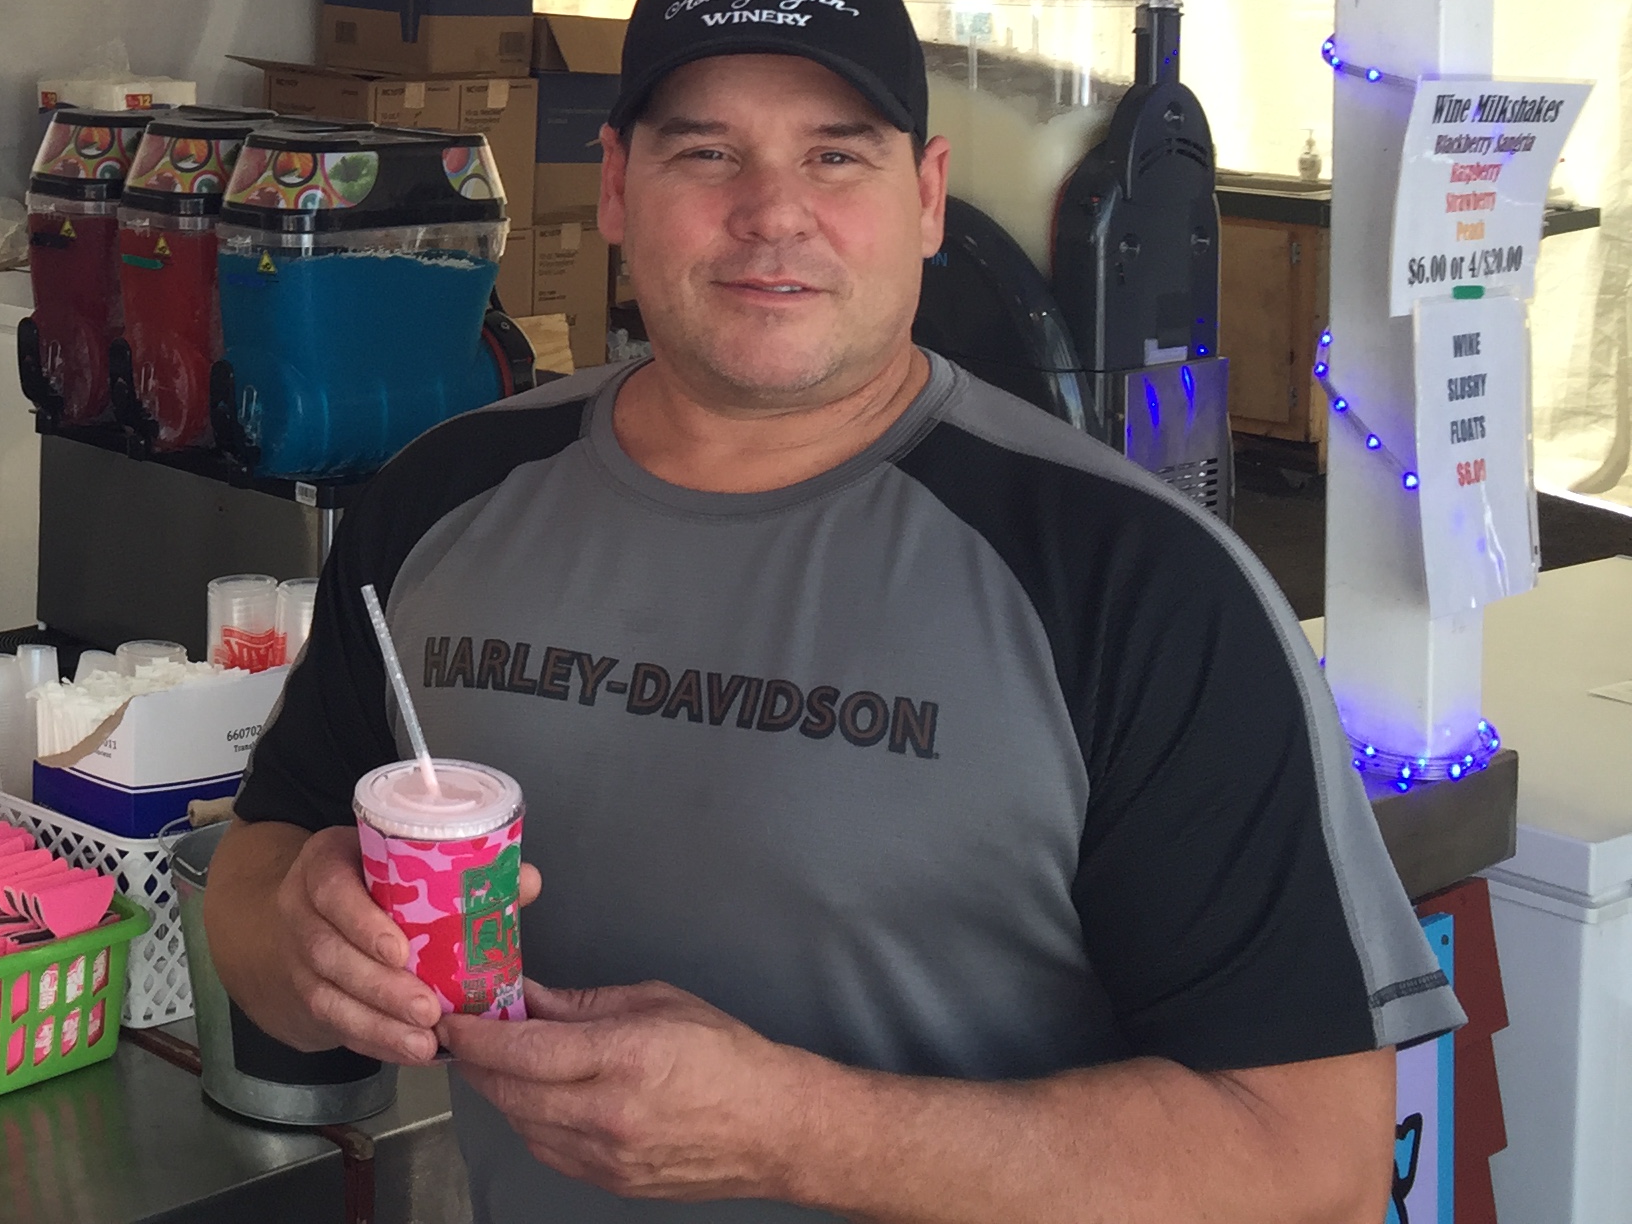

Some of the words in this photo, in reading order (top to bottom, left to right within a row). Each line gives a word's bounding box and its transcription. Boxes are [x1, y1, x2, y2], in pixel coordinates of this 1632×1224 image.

[700, 9, 814, 27] WINERY
[1431, 94, 1472, 124] Wine
[1472, 94, 1566, 124] Milkshakes
[1434, 134, 1494, 156] Blackberry
[1494, 132, 1536, 156] Sangria
[1407, 254, 1447, 287] $6.00
[1450, 256, 1465, 281] or
[1467, 245, 1523, 279] 4/$20.00
[1452, 331, 1481, 359] WINE
[1447, 372, 1488, 402] SLUSHY
[1450, 415, 1486, 445] FLOATS
[423, 634, 939, 760] HARLEY-DAVIDSON
